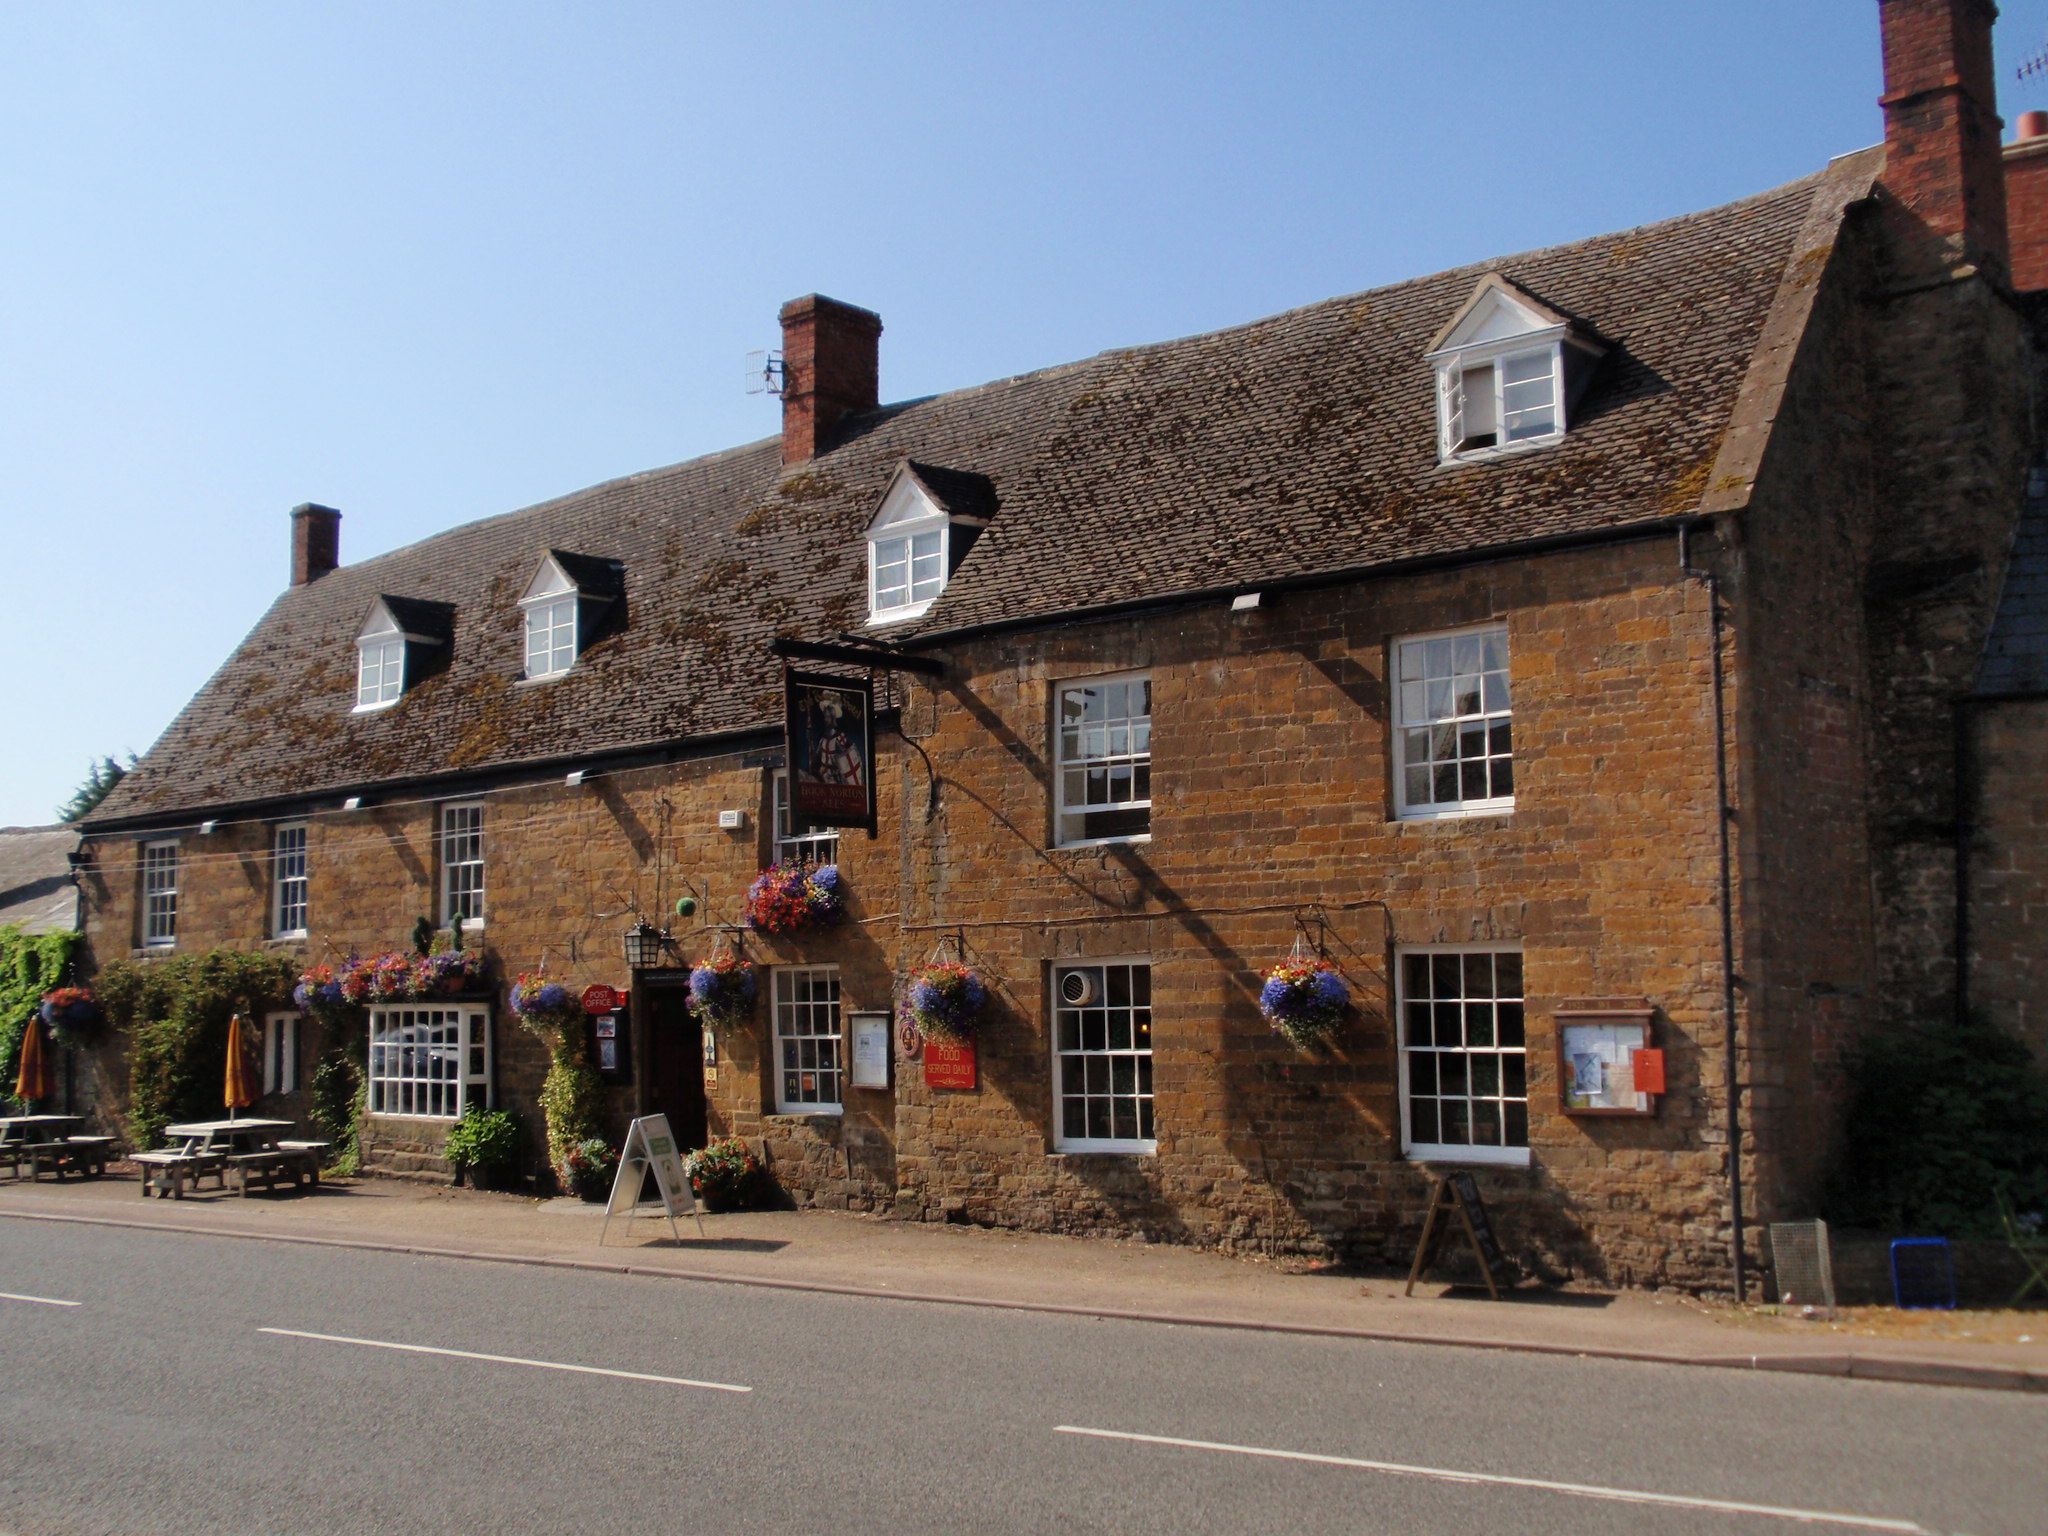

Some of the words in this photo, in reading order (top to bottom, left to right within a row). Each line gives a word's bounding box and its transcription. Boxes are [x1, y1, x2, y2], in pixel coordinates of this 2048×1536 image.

[830, 788, 865, 799] NORTON
[589, 990, 608, 999] POST
[586, 999, 612, 1008] OFFICE
[938, 1049, 960, 1061] FOOD
[928, 1064, 950, 1075] SERVED
[953, 1064, 972, 1075] DAILY
